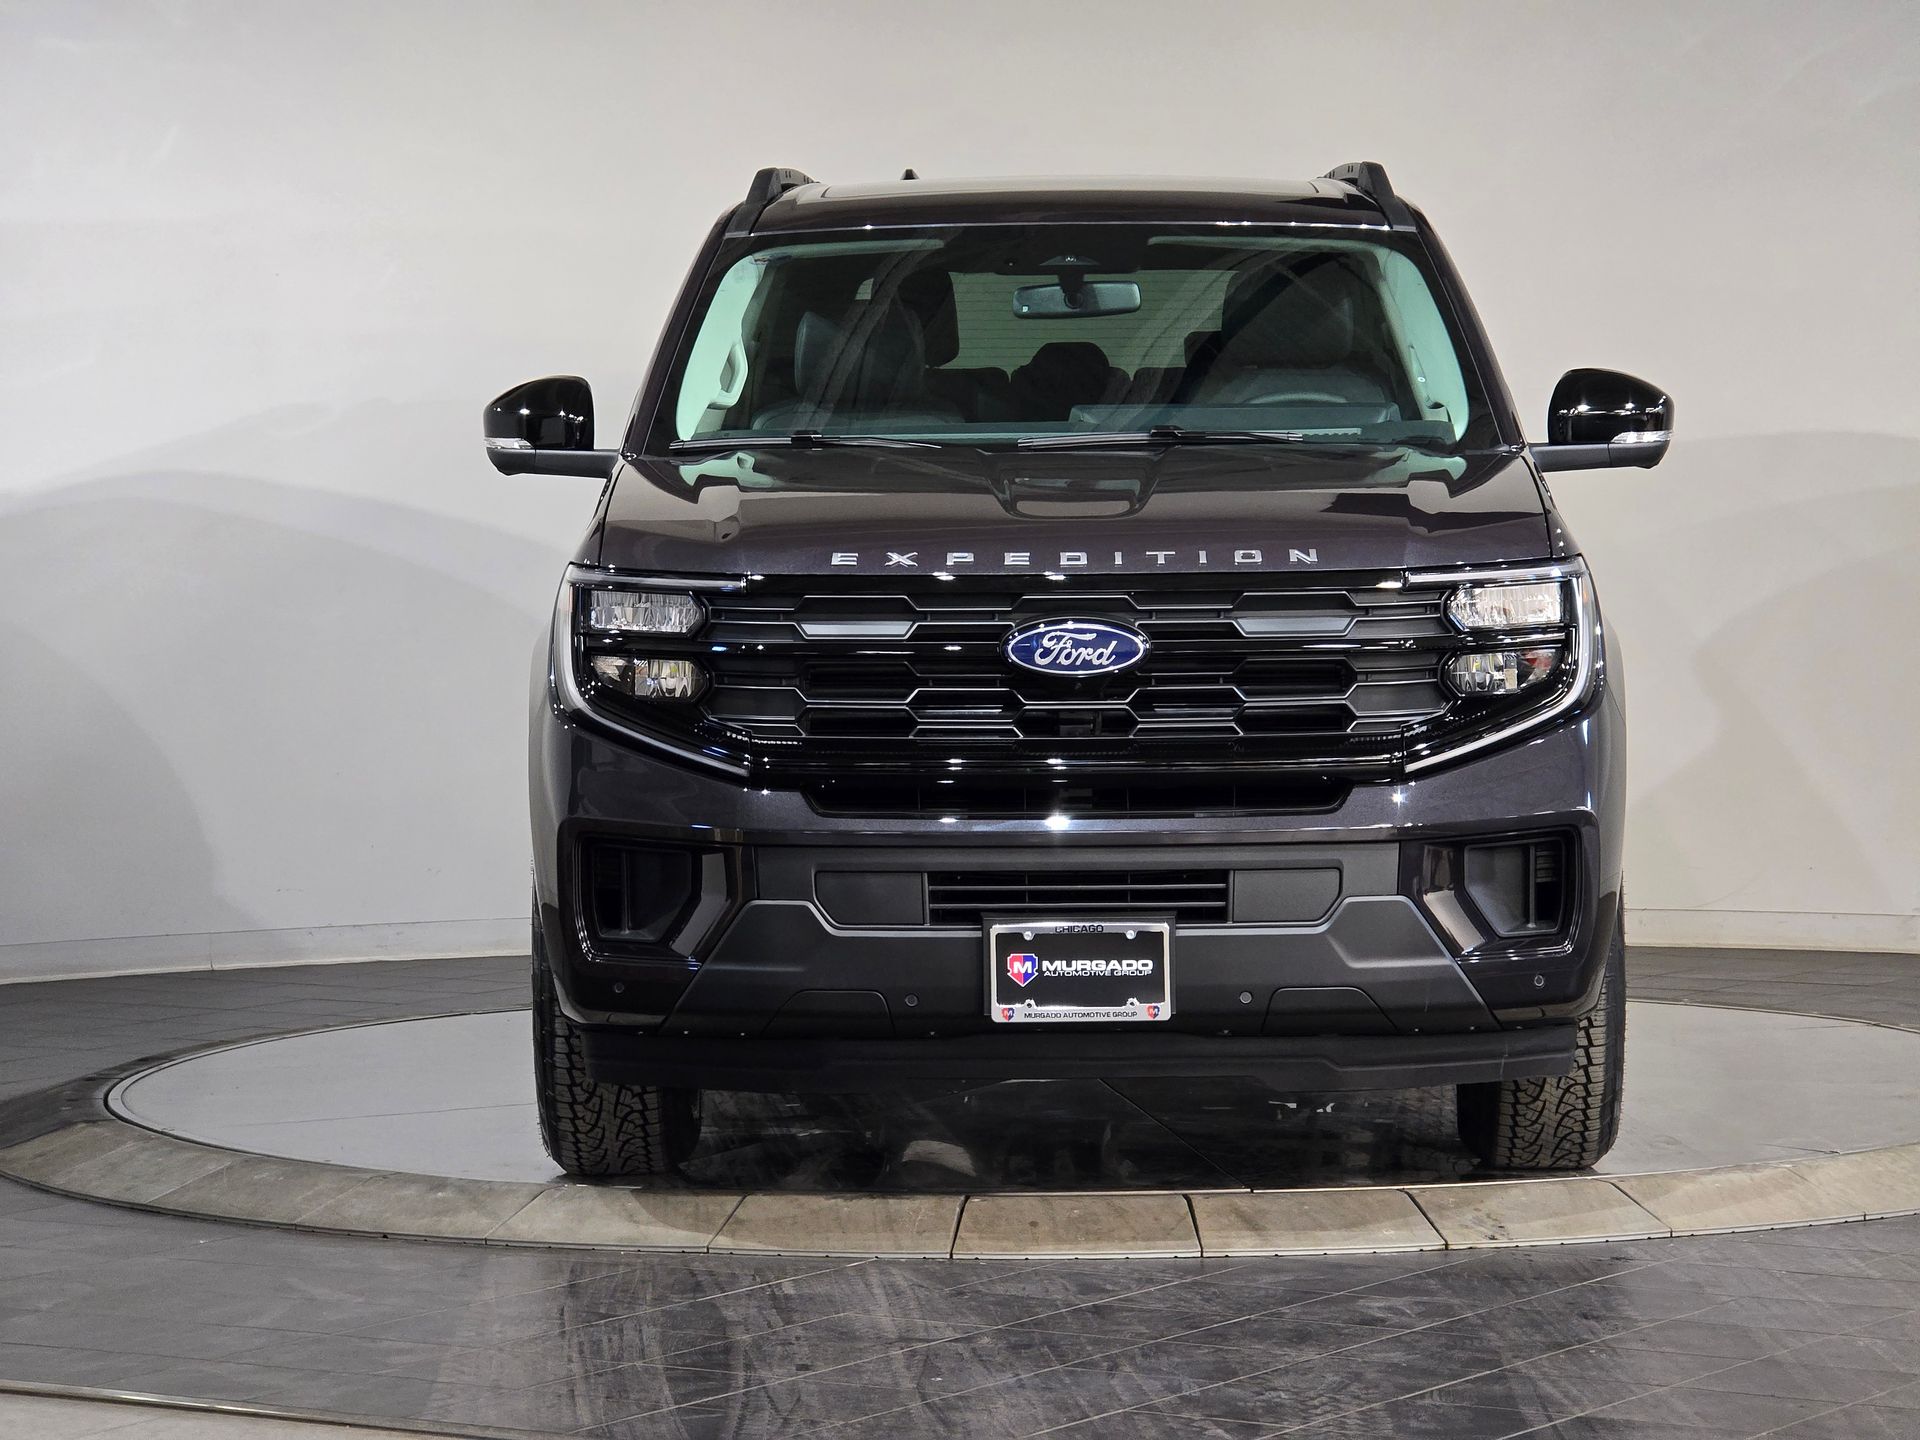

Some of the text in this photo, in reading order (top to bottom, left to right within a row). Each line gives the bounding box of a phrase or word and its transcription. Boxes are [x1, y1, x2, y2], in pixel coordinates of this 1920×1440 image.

[831, 549, 1318, 567] EXPEDITION
[1034, 631, 1117, 667] Ford
[1055, 925, 1104, 933] CHICAGO
[1042, 960, 1153, 971] MURGADO
